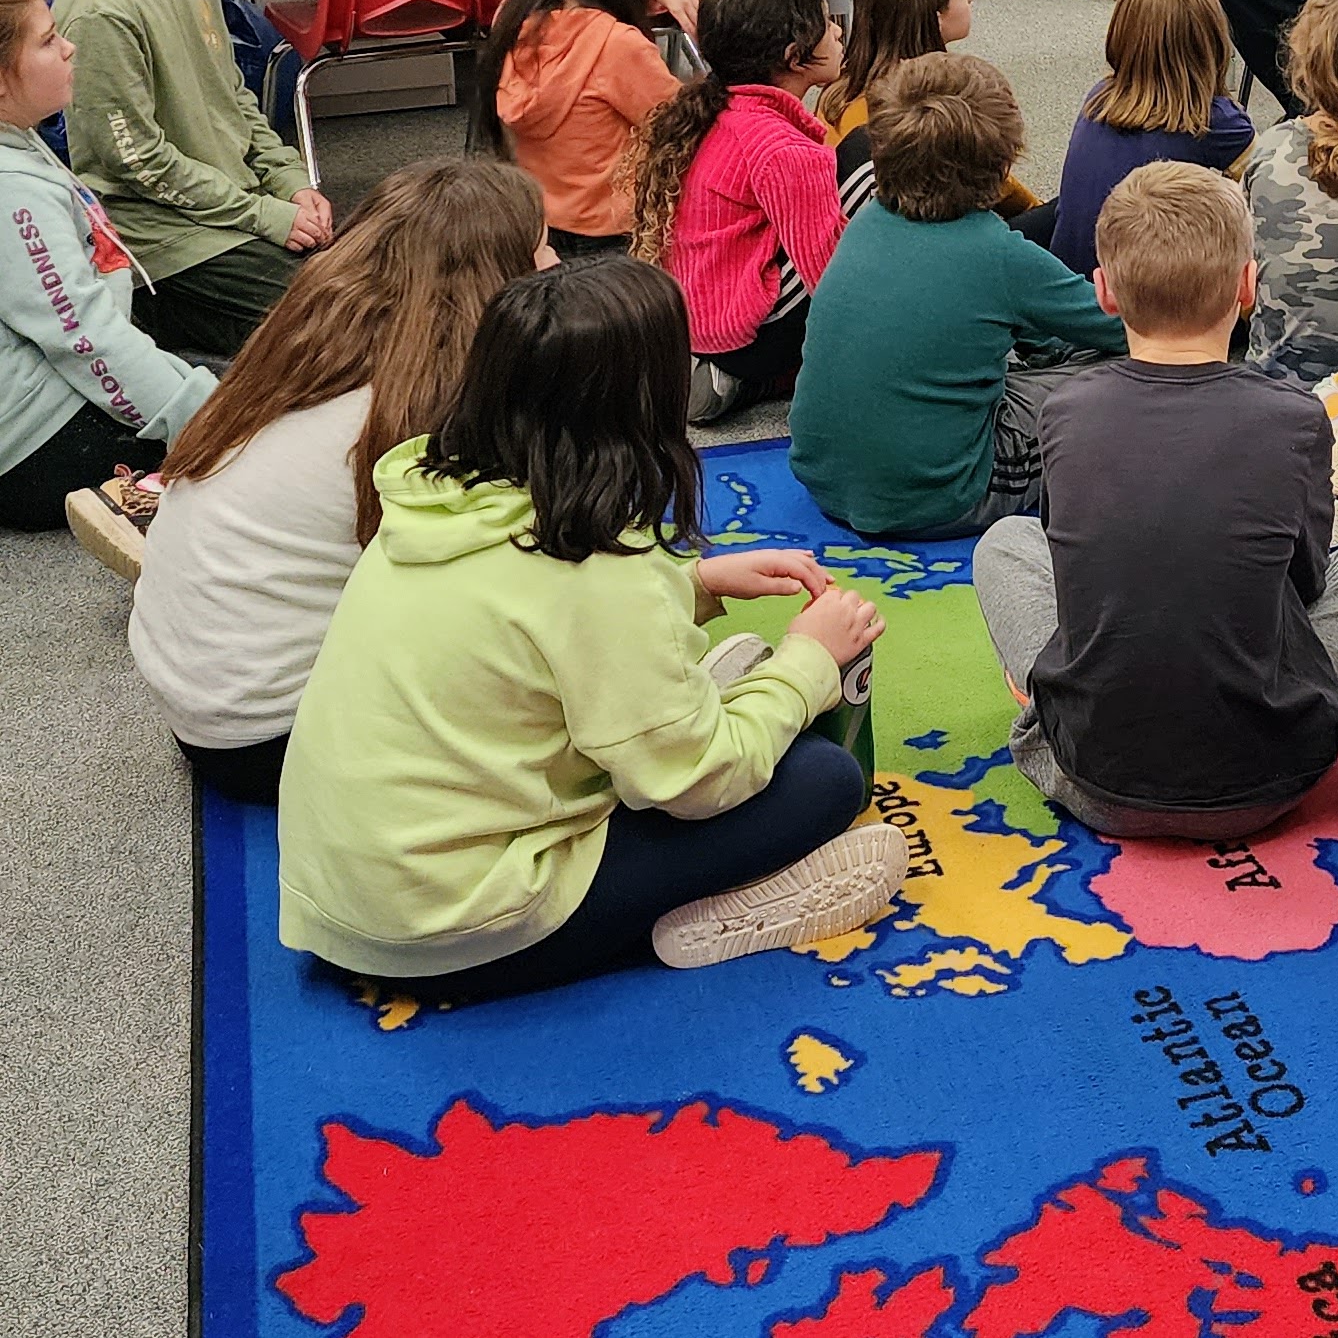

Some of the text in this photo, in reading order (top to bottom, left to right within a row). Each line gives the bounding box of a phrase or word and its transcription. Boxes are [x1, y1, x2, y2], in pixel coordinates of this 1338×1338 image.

[13, 208, 80, 333] KINDNESS
[73, 335, 94, 354] &
[872, 781, 944, 879] Europe
[1131, 985, 1271, 1156] Atlantic
[1204, 991, 1304, 1118] Ocean
